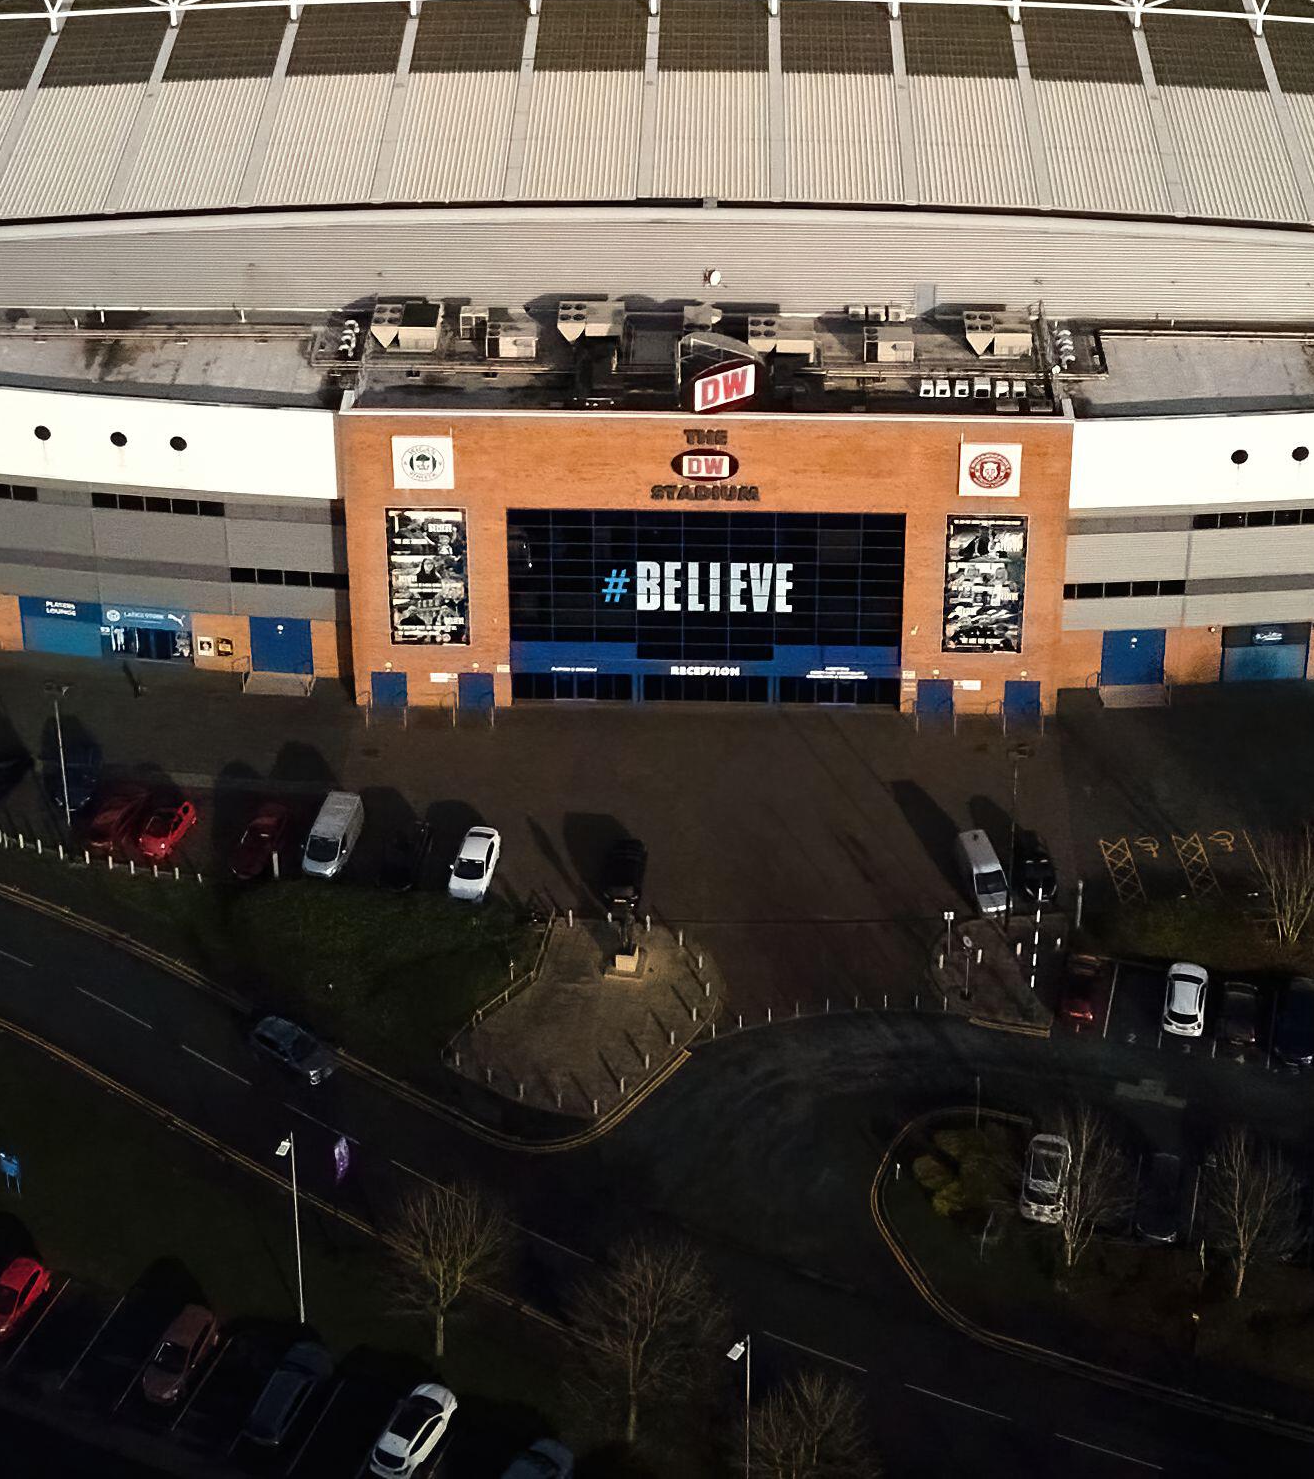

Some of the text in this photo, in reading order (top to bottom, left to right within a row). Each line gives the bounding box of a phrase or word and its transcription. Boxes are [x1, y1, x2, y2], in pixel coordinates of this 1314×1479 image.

[700, 368, 748, 408] DW
[683, 429, 728, 445] THE
[687, 457, 724, 475] DW
[650, 485, 760, 501] STADIUM
[670, 666, 740, 676] RECEPTION
